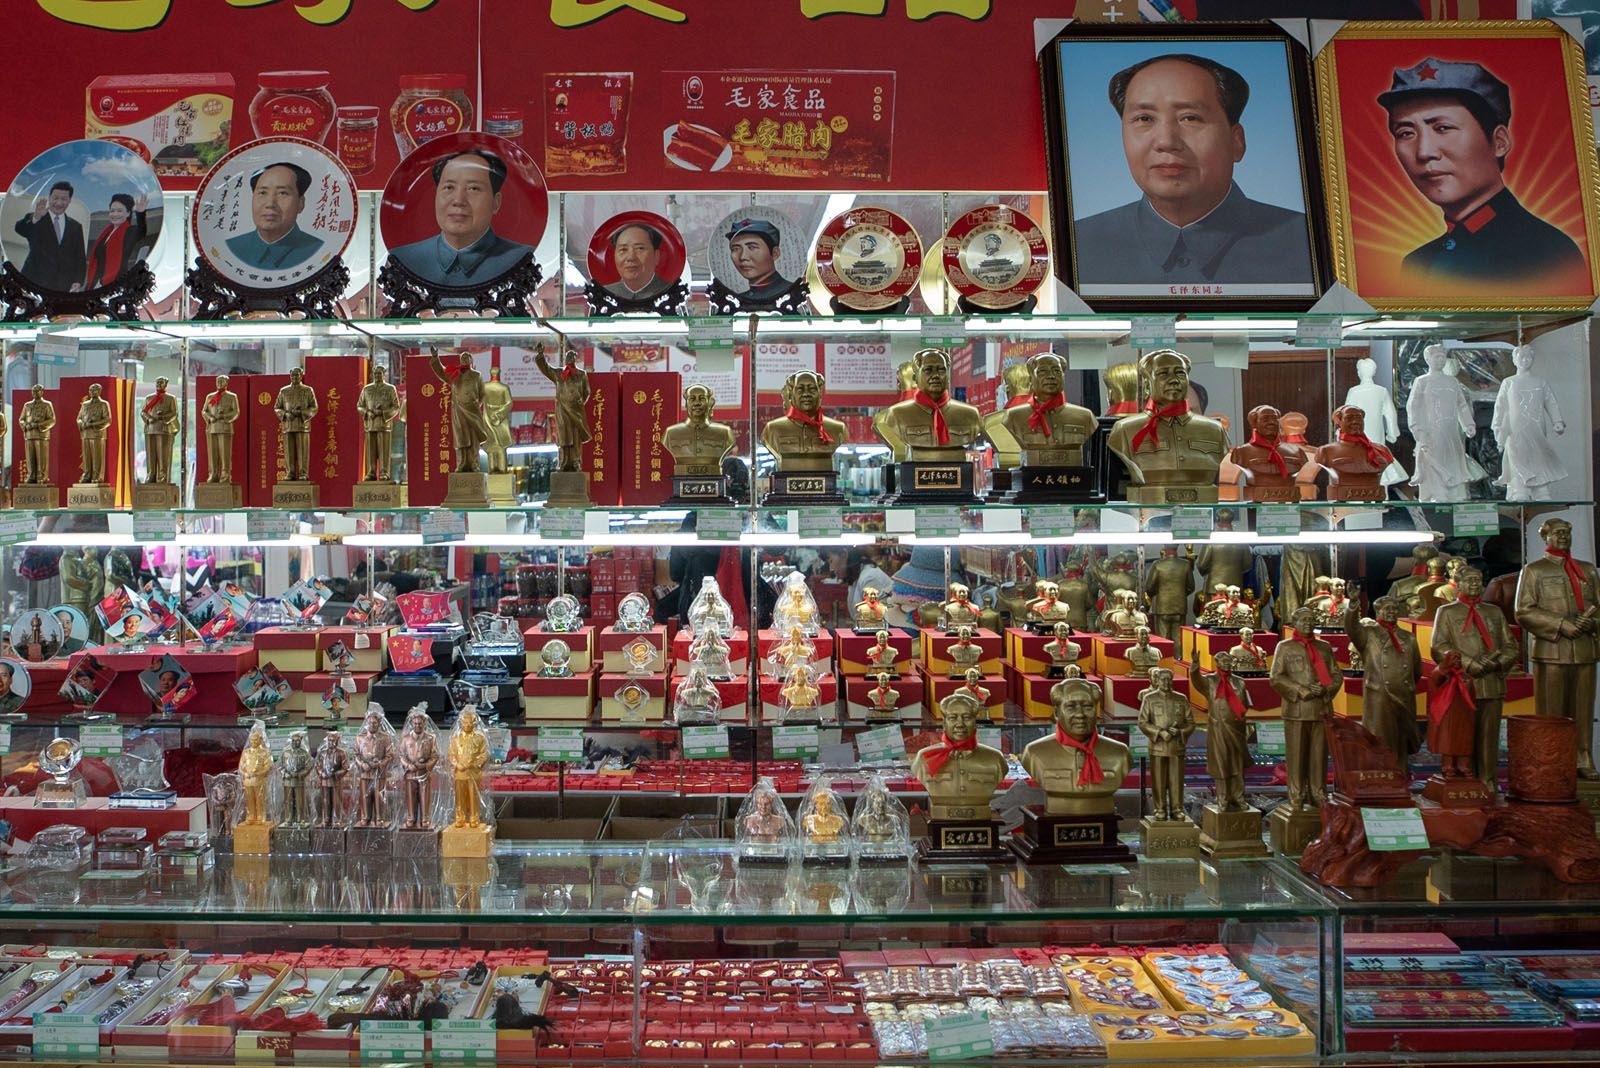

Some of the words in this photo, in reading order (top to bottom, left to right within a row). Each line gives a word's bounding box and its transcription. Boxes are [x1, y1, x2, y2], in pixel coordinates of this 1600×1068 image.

[725, 84, 825, 110] 毛家食品
[732, 118, 832, 151] 毛家腊肉
[224, 260, 315, 283] 一代领袖毛泽东
[1168, 285, 1224, 295] 毛泽东同志
[1032, 474, 1081, 485] 人民领袖
